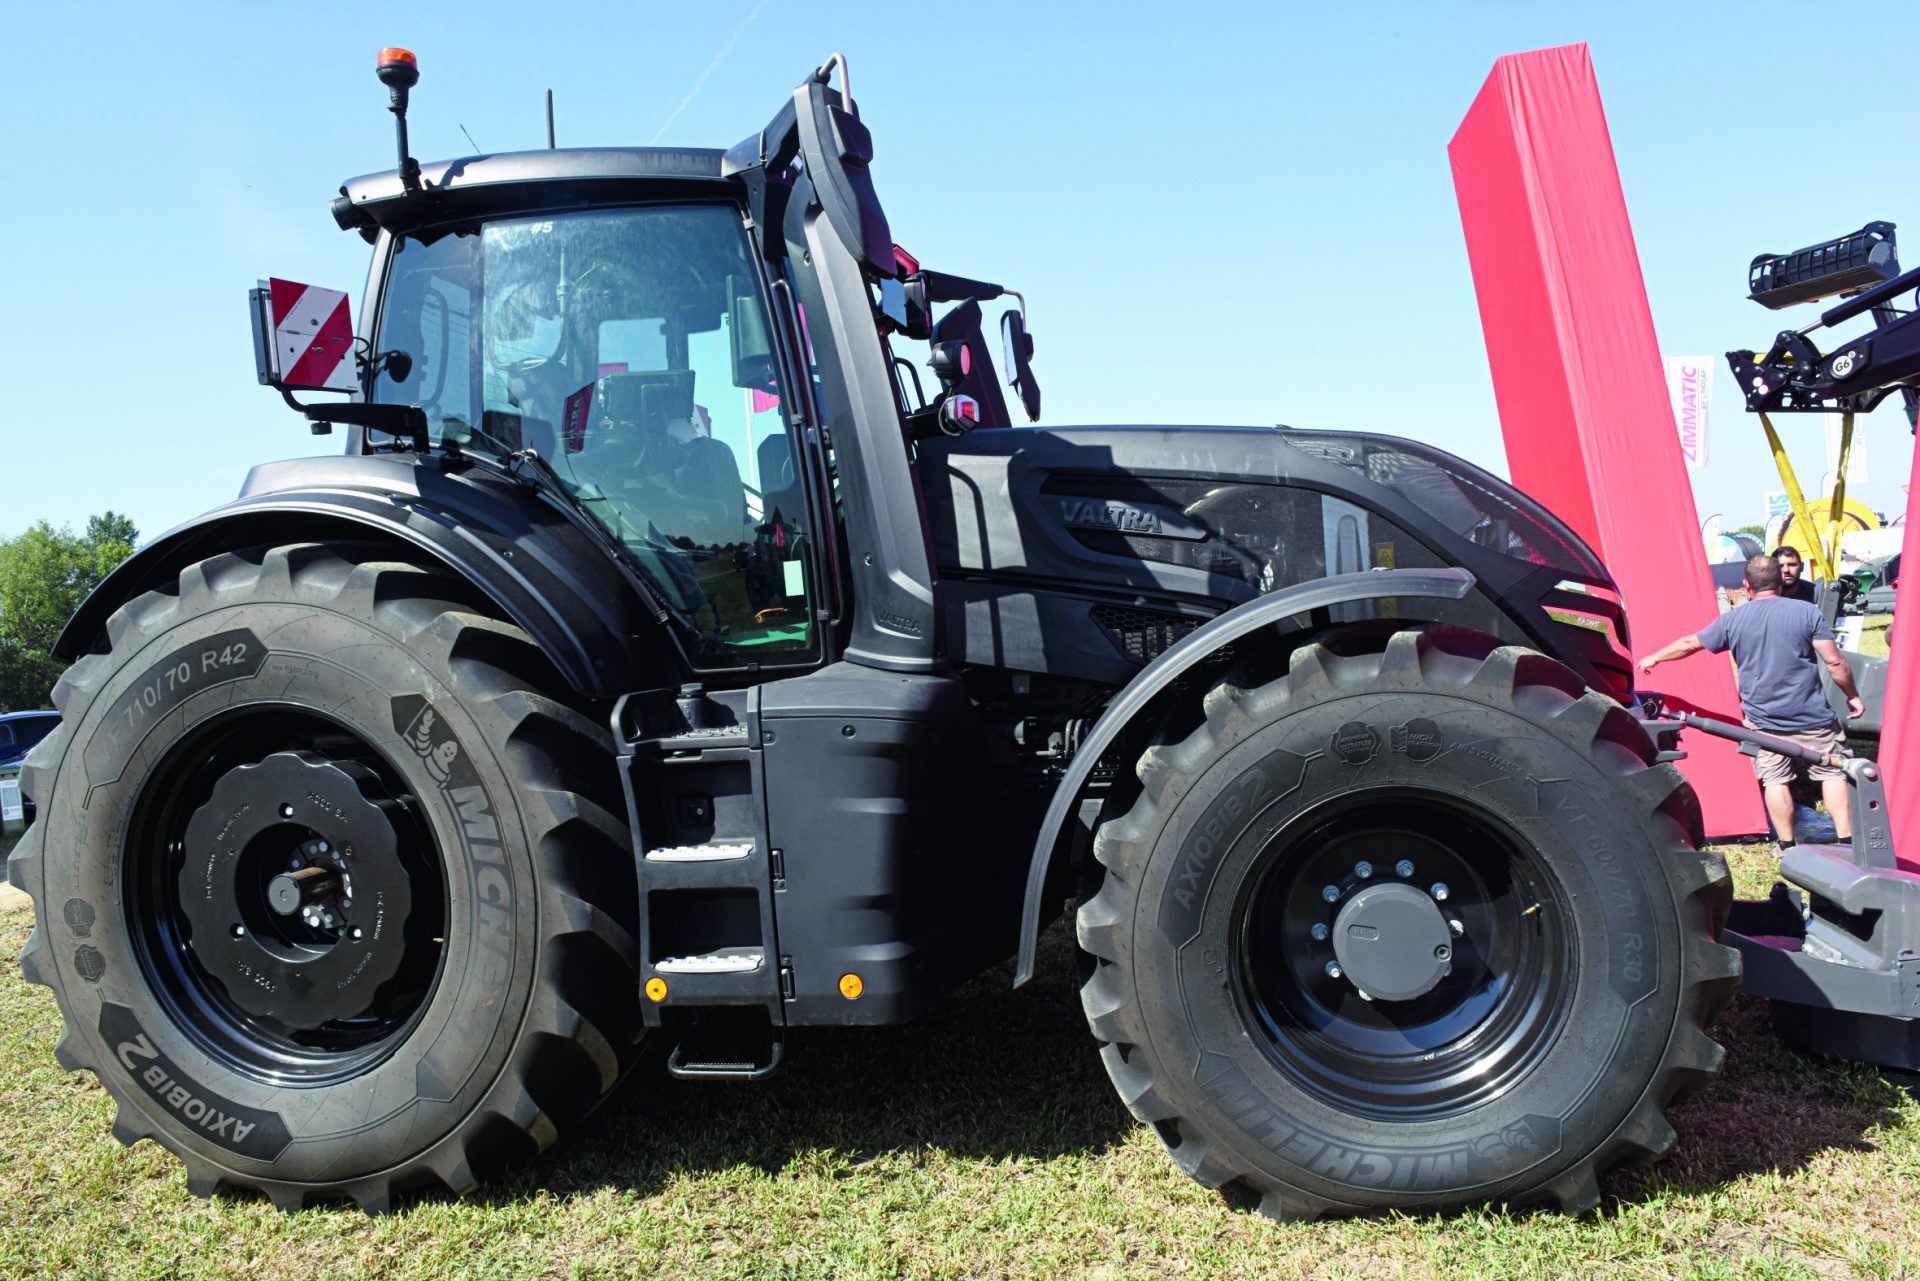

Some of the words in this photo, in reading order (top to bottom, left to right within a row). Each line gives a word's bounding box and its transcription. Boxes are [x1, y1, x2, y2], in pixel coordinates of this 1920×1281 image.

[1835, 359, 1850, 372] G6
[1682, 366, 1697, 462] ZIMMATIC
[1060, 501, 1163, 533] VALTRA
[878, 610, 922, 633] VALTRA
[201, 643, 247, 673] R42
[1408, 733, 1434, 742] HIGH
[1173, 794, 1246, 912] AXIOBIB
[1239, 768, 1273, 805] 2
[1623, 932, 1643, 983] R30
[116, 1033, 160, 1071] 2
[142, 1065, 257, 1144] AXIOBIB
